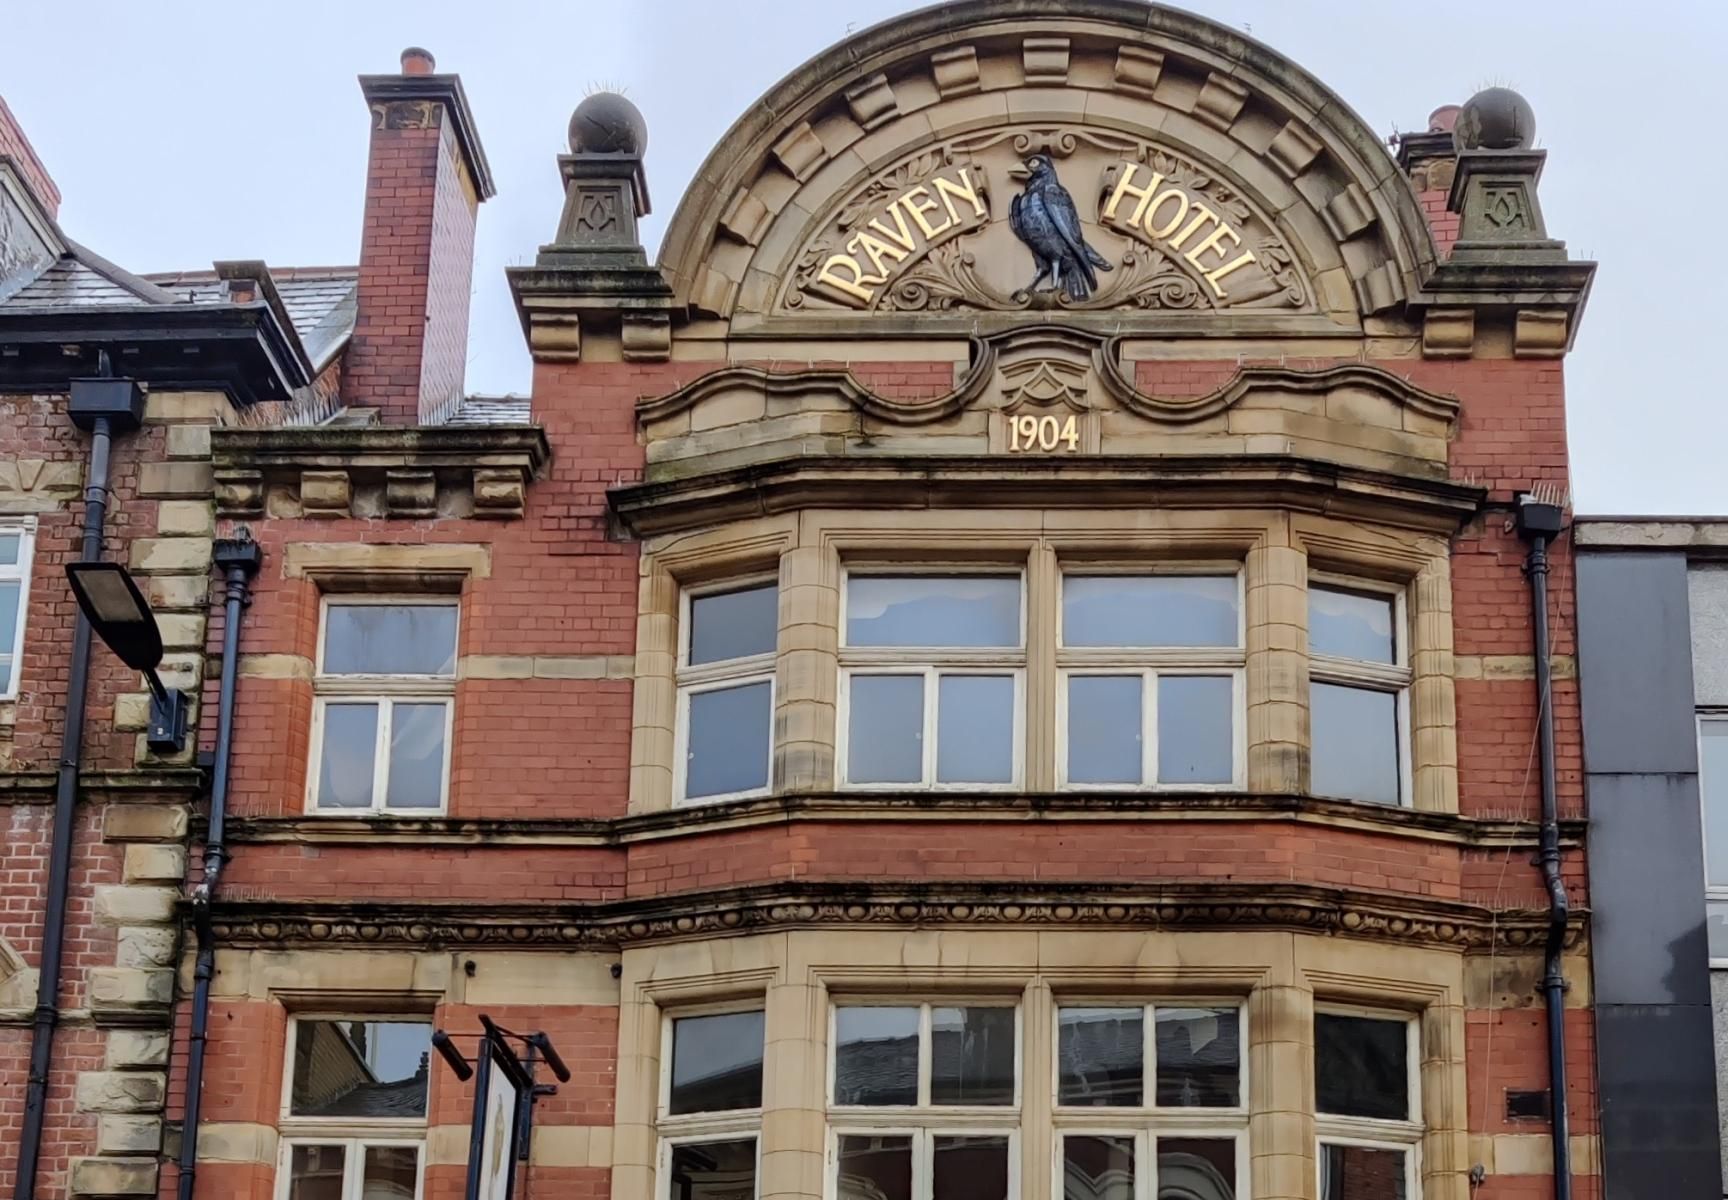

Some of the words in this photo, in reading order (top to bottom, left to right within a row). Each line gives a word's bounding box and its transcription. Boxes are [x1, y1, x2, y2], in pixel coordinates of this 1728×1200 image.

[817, 168, 987, 303] RAVEN
[1104, 162, 1257, 299] HOTEL
[1009, 414, 1079, 451] 1904
